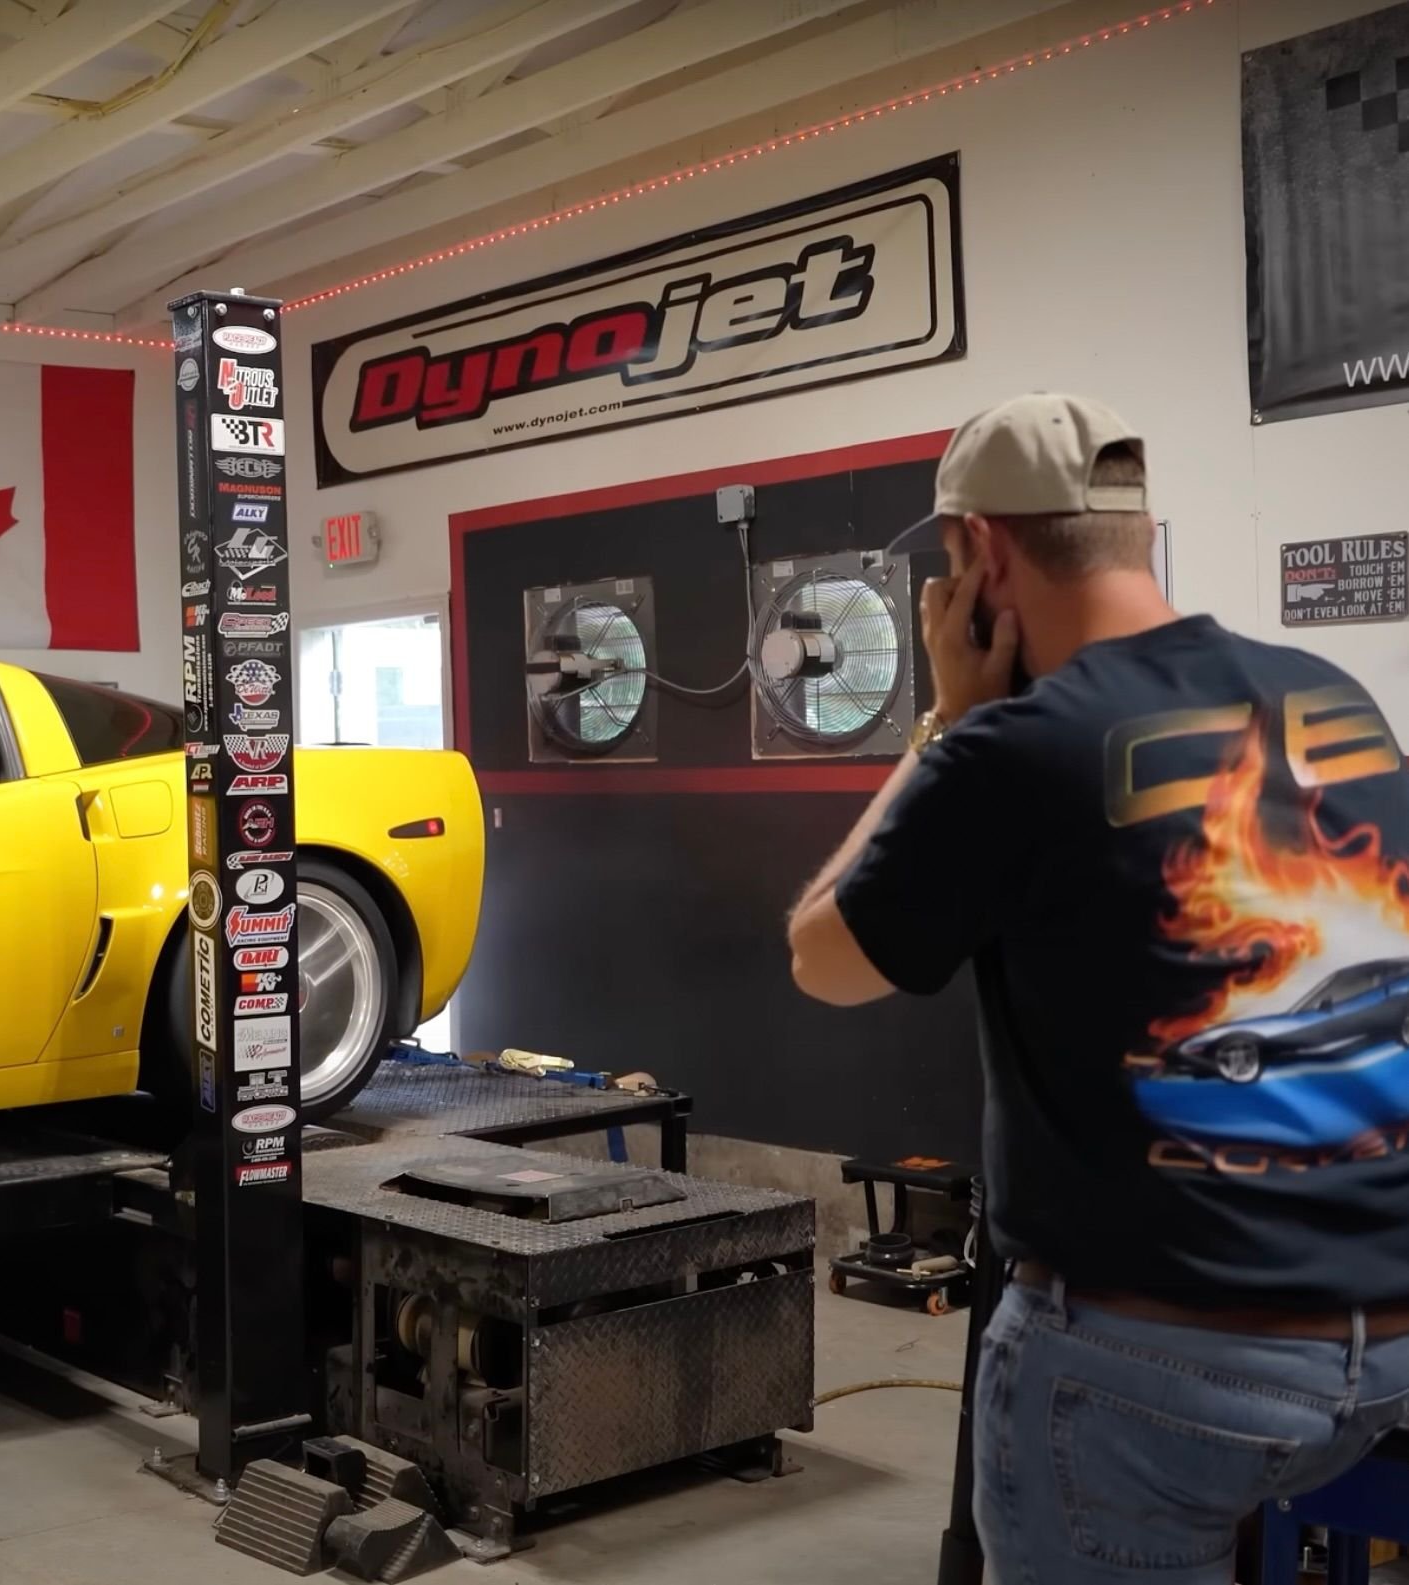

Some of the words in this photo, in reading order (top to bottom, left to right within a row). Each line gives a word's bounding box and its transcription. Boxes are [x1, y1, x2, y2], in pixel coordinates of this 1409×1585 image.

[348, 236, 876, 433] Dynojet
[218, 358, 276, 389] NITROUS
[229, 382, 279, 410] OUTLET
[492, 398, 622, 436] www.dynojet.com
[218, 482, 282, 495] MAGNUSON
[235, 508, 265, 518] ALKY
[327, 514, 362, 561] EXIT
[1284, 543, 1335, 568] TOOL
[1341, 540, 1406, 562] RULES
[1349, 563, 1383, 577] TOUCH
[1338, 576, 1383, 591] BORROW
[1354, 589, 1383, 602] MOVE
[1284, 608, 1311, 621] DON'T
[1314, 606, 1338, 619] EVEN
[1341, 604, 1366, 617] LOOK
[1369, 602, 1383, 615] AT
[238, 642, 283, 653] PFADT
[183, 635, 196, 704] RPM
[232, 776, 285, 788] ARP
[239, 998, 275, 1010] COMP
[256, 1136, 285, 1150] RPM
[239, 1166, 288, 1186] FLOWMASTER
